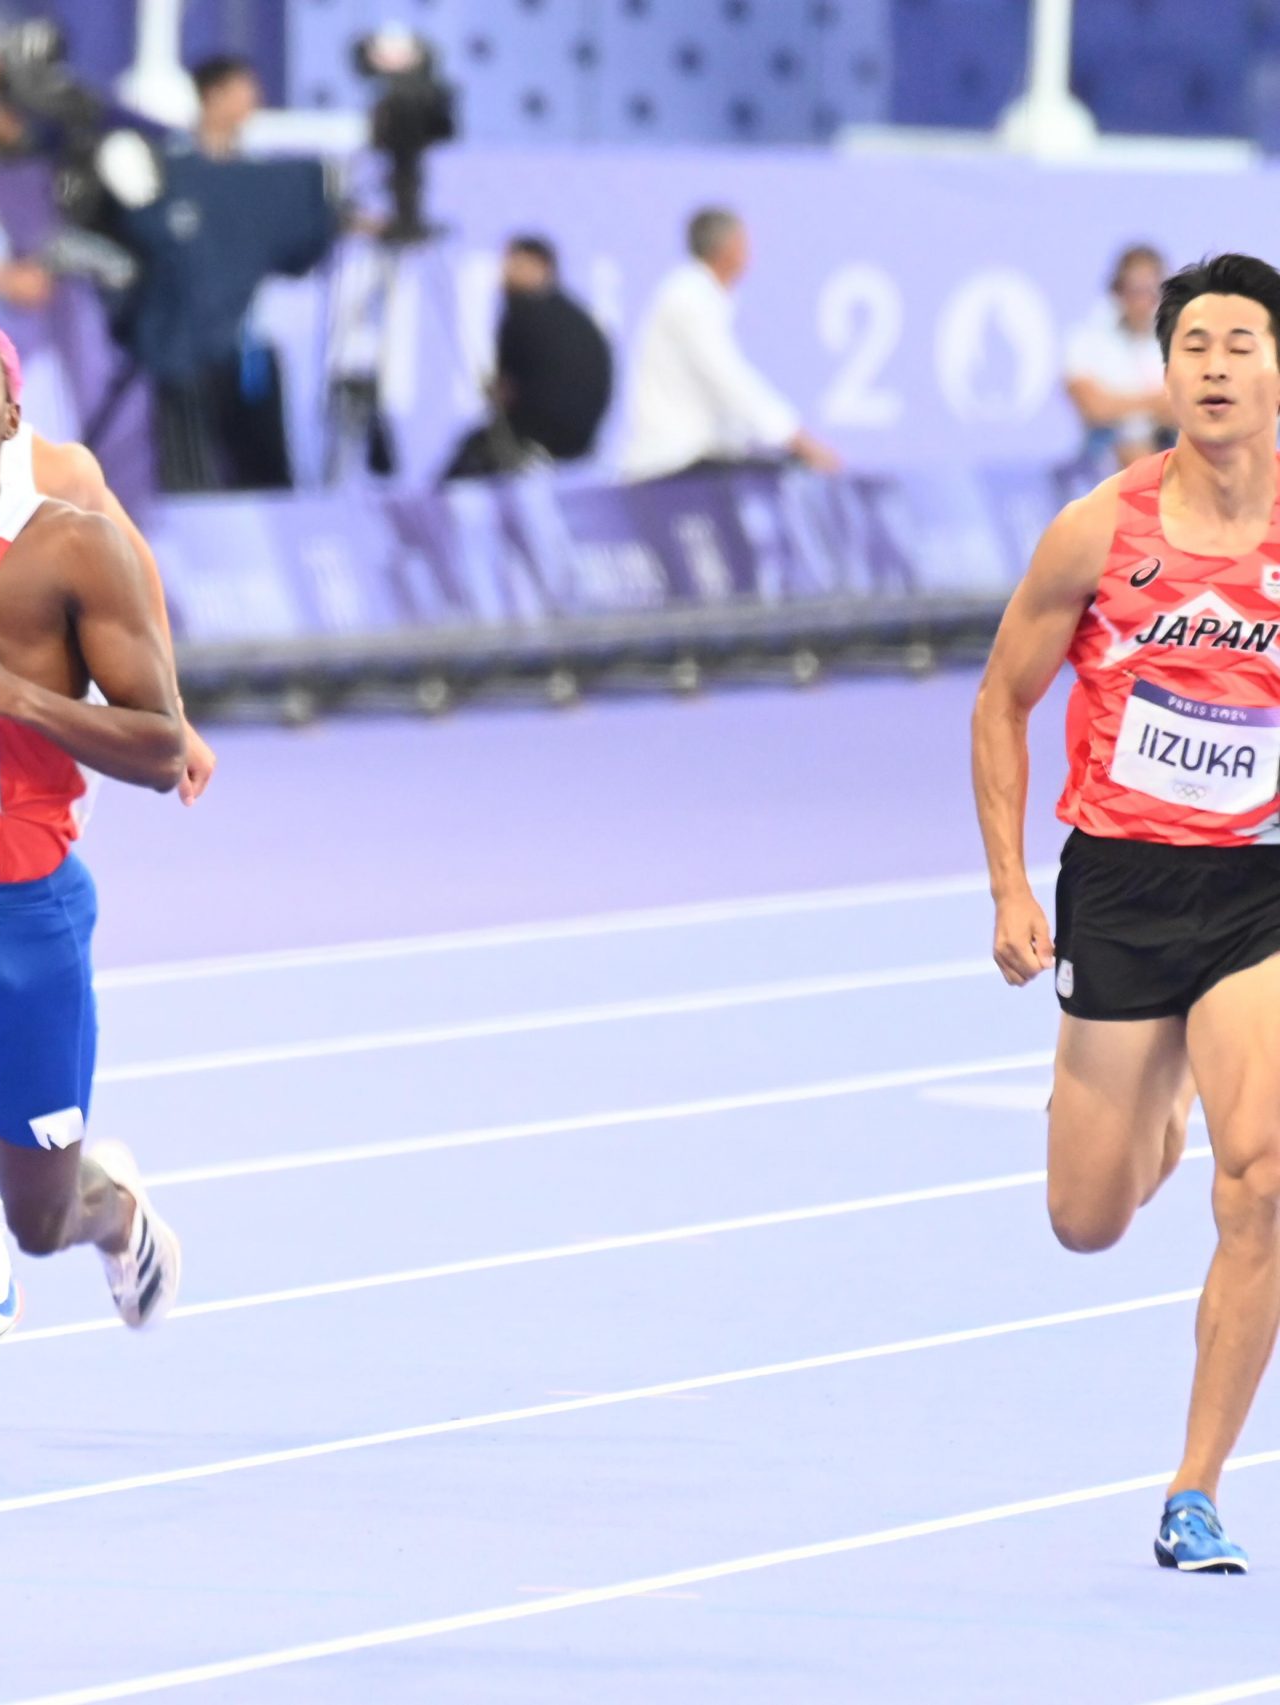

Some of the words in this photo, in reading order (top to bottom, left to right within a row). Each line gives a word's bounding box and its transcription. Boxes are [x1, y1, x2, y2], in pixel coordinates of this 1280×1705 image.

[1135, 614, 1280, 652] JAPAN
[1167, 695, 1207, 717] PARIS
[1210, 706, 1248, 721] 2024
[1138, 723, 1257, 779] IIZUKA
